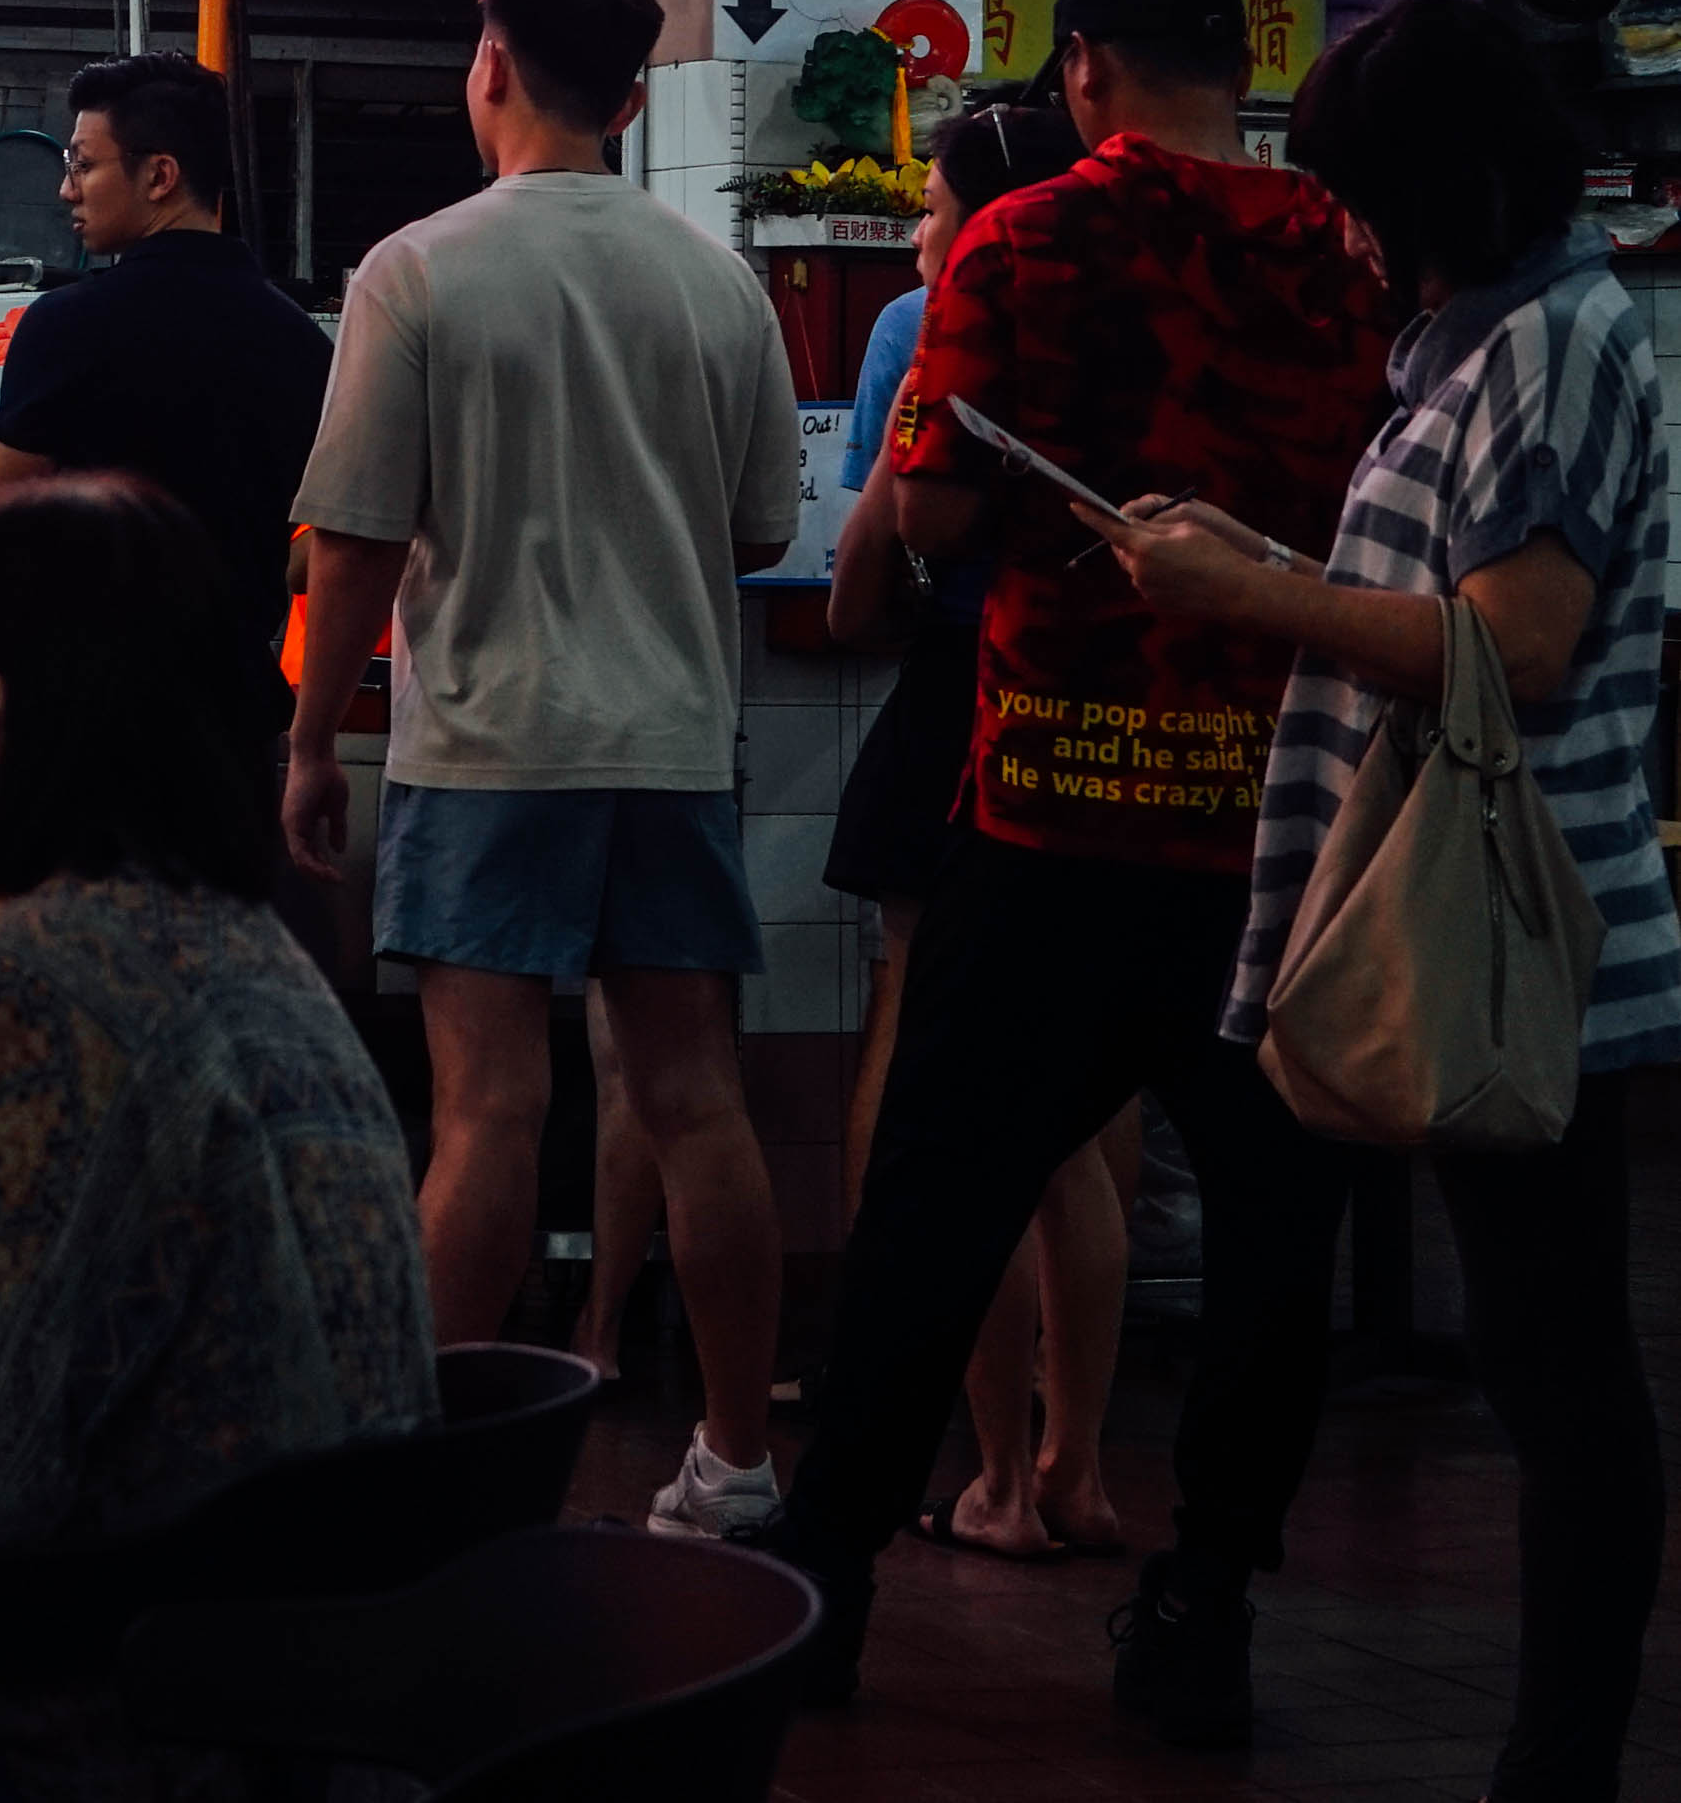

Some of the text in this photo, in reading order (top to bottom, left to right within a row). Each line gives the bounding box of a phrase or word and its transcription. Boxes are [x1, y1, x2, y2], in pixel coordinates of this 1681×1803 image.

[831, 219, 907, 243] 百财聚来
[997, 686, 1069, 723] your
[1080, 701, 1148, 737] pop
[1158, 704, 1260, 742] caught
[1052, 733, 1122, 765] and
[1131, 736, 1175, 771] he
[1000, 755, 1039, 790] He
[1051, 771, 1123, 802] was
[1133, 779, 1224, 816] crazy
